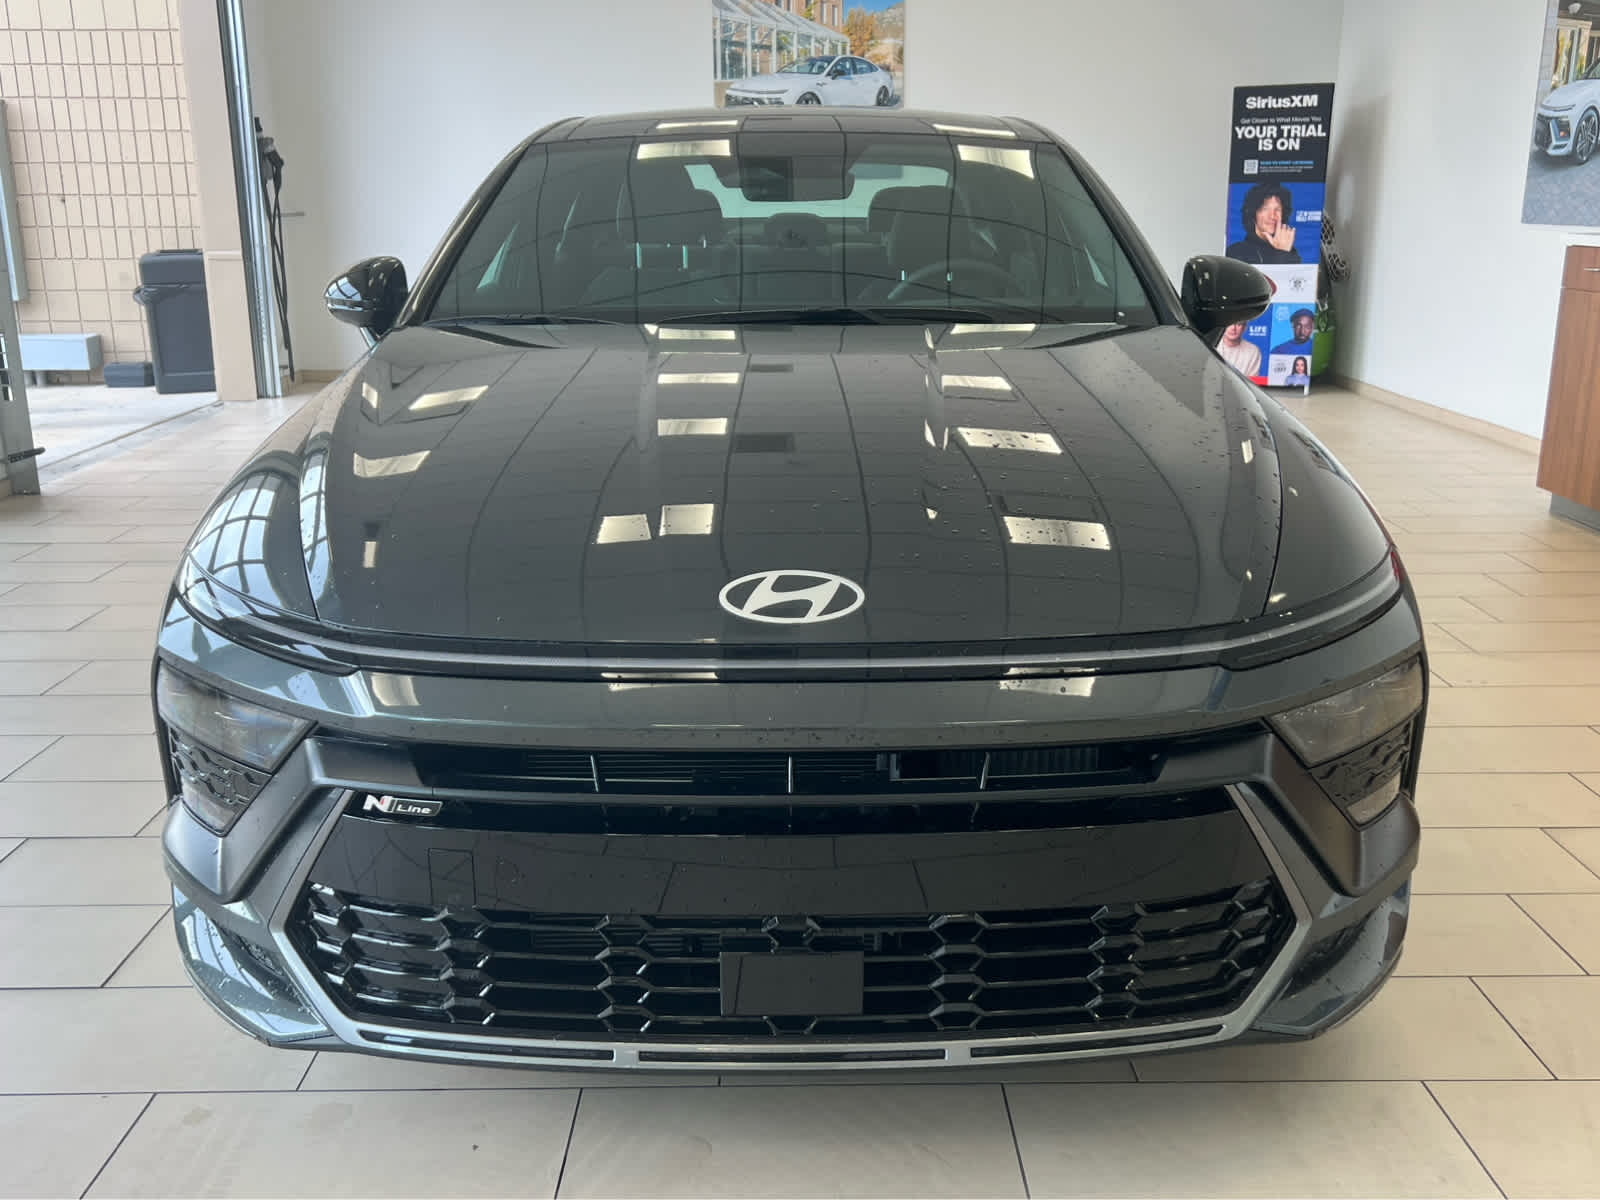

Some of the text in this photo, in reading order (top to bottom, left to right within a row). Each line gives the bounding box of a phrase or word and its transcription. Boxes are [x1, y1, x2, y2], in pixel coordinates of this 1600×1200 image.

[1245, 94, 1319, 109] SiriusXM
[1235, 124, 1326, 138] YOUR TRIAL
[1258, 138, 1300, 151] IS ON
[363, 794, 432, 814] N Line
